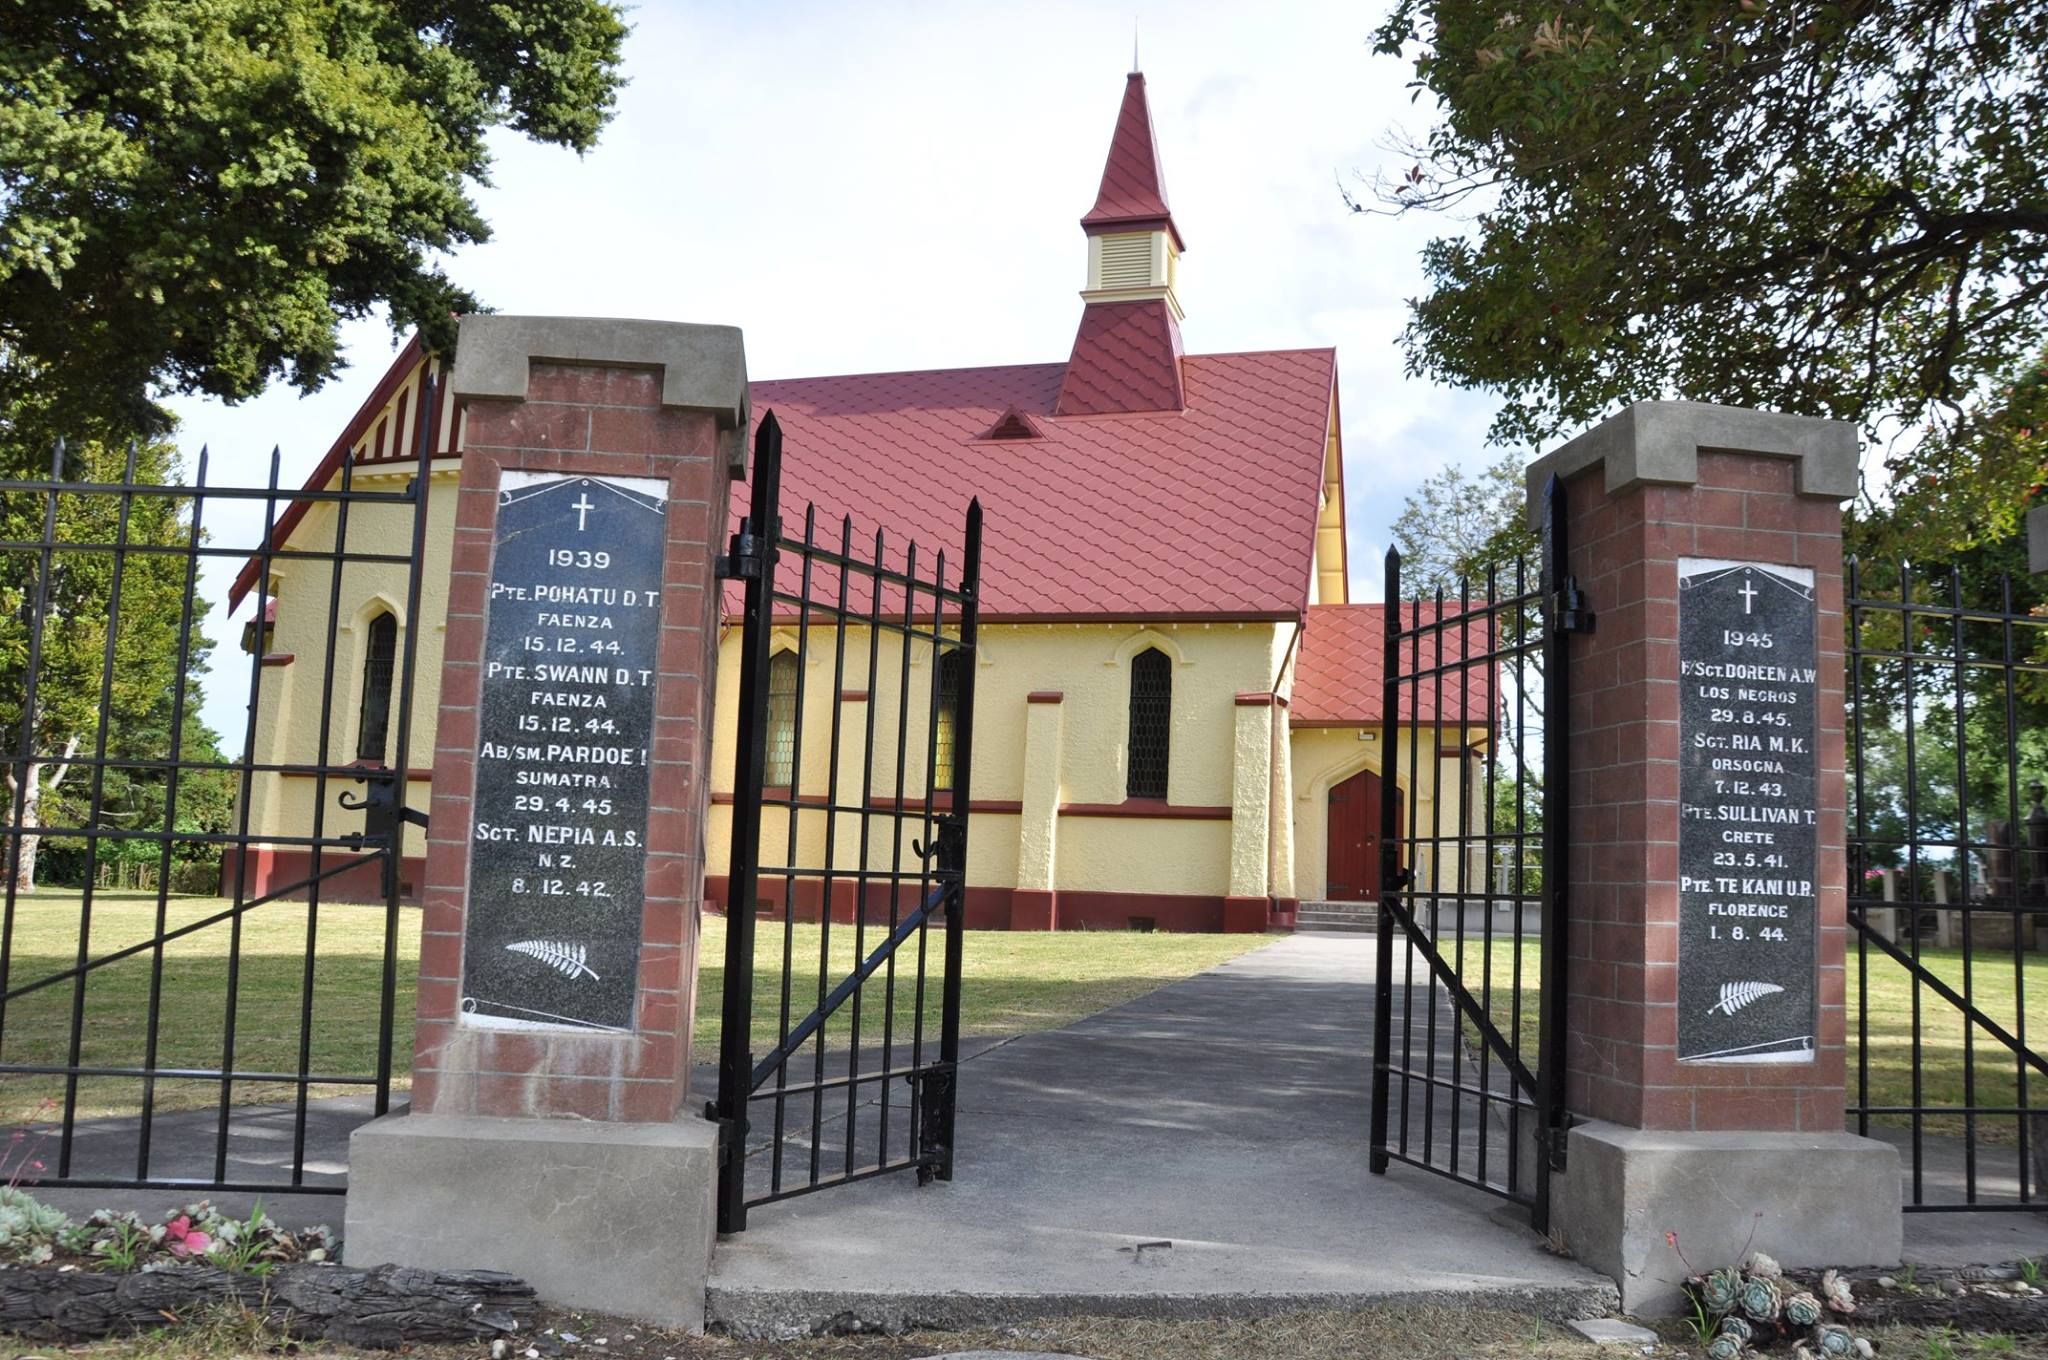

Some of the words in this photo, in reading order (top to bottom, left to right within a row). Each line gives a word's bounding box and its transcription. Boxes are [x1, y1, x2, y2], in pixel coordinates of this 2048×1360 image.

[549, 549, 610, 569] 1939
[538, 613, 613, 629] FAENZA
[1723, 630, 1773, 648] 1945
[531, 692, 607, 708] FAENZA
[1699, 686, 1729, 700] LOS
[1738, 689, 1797, 704] NEGROS
[1712, 758, 1784, 774] ORSOGNA
[516, 771, 611, 789] SUMATRA
[476, 823, 520, 842] SGT.
[602, 829, 643, 848] A.S.
[1722, 831, 1775, 844] CRETE
[1742, 879, 1783, 895] KANI
[1708, 903, 1788, 918] FLORENCE
